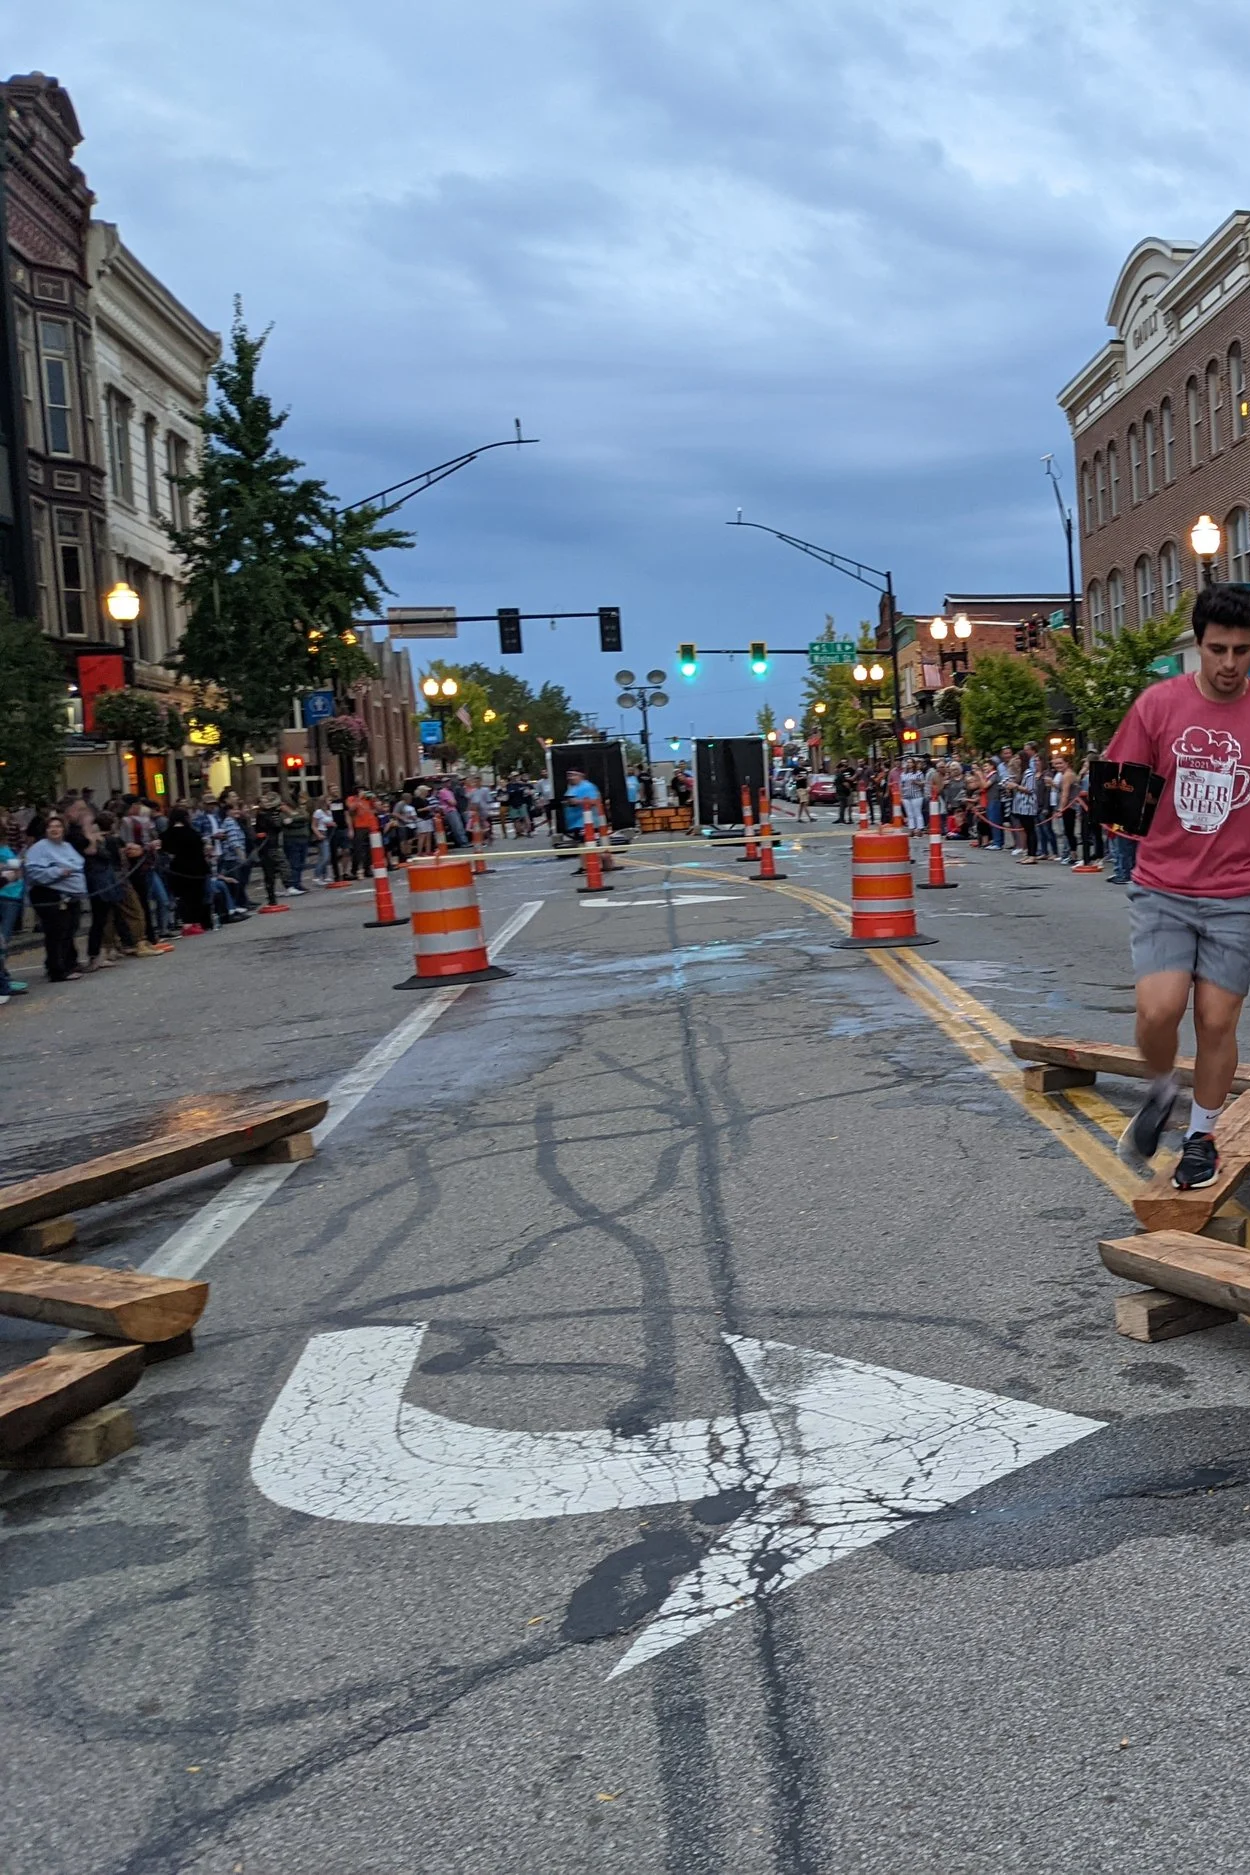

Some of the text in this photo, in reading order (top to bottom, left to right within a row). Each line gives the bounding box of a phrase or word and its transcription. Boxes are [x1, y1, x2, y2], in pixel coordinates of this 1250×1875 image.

[1190, 760, 1209, 769] 2021
[1180, 782, 1228, 802] BEER
[1179, 798, 1225, 816] STEIN
